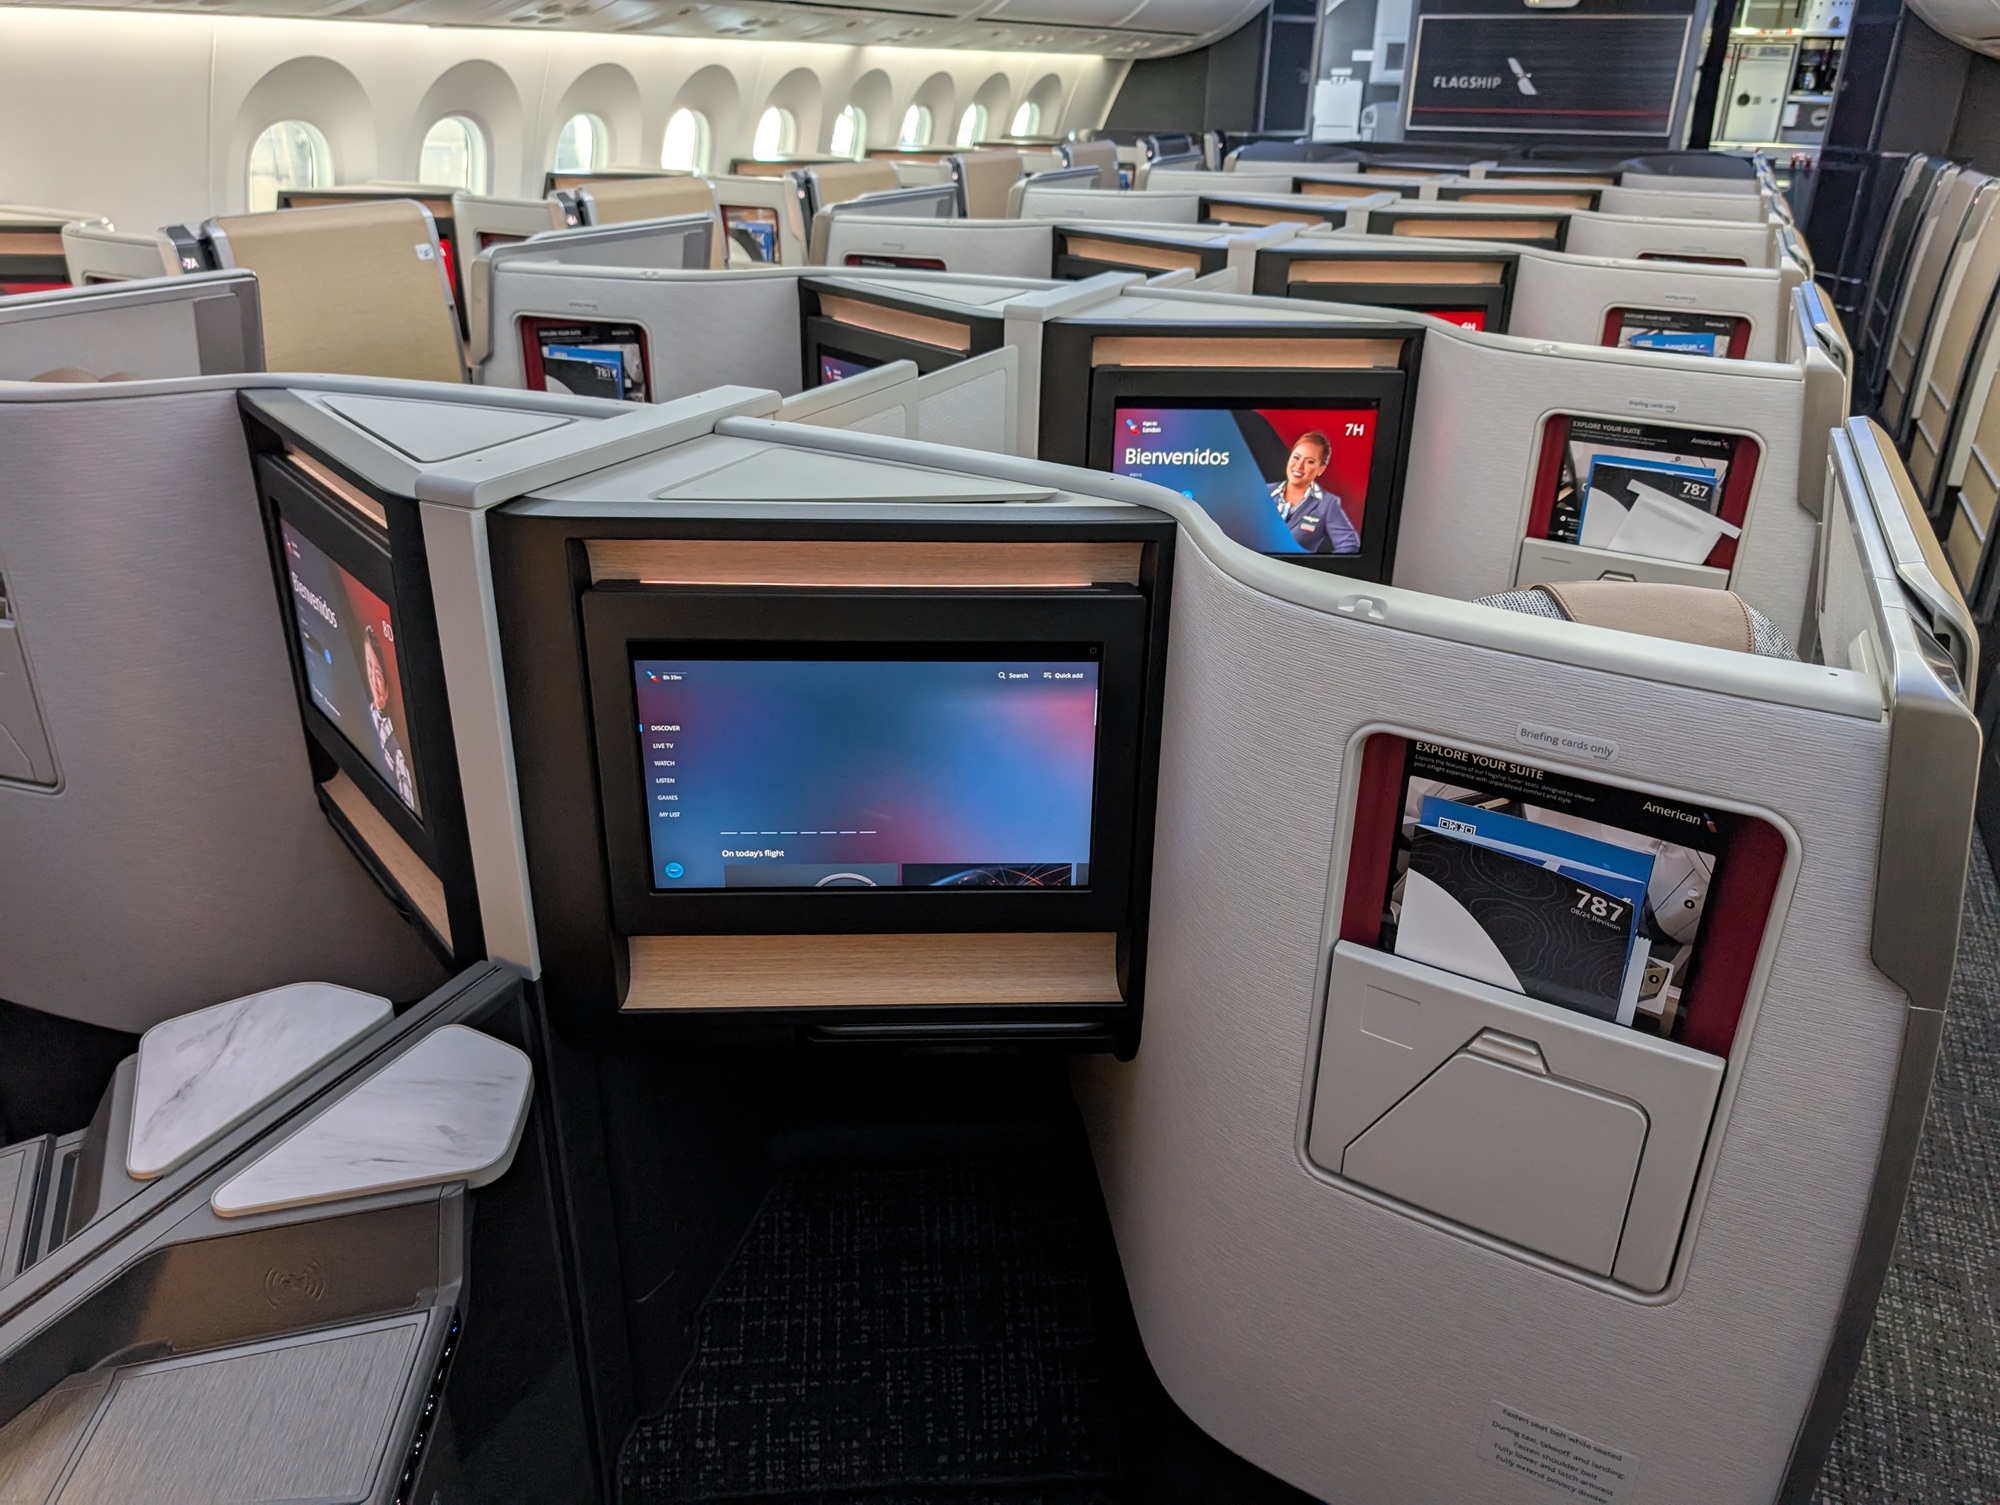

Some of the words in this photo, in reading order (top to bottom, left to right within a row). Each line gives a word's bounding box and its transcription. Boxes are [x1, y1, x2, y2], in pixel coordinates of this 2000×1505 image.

[1433, 76, 1502, 89] FLAGSHIP
[1345, 423, 1365, 436] 7H
[1572, 421, 1601, 430] EXPLORE
[1602, 424, 1622, 433] YOUR
[1622, 426, 1641, 435] SUITE
[1690, 437, 1721, 447] American
[1125, 447, 1230, 466] Bienvenidos
[1682, 481, 1709, 497] 787
[291, 570, 338, 629] Bienvenidos
[1520, 728, 1559, 746] Briefing
[1561, 738, 1588, 751] cards
[1590, 745, 1613, 758] only
[1415, 754, 1435, 764] Explore
[1445, 761, 1467, 771] features
[1416, 742, 1469, 762] EXPLORE
[1472, 754, 1506, 771] YOUR
[1509, 763, 1544, 780] SUITE
[1446, 768, 1474, 779] experience
[1522, 787, 1545, 798] comfort
[1643, 801, 1701, 825] American
[764, 849, 785, 859] flight
[1576, 888, 1624, 922] 787
[1570, 907, 1591, 919] 08/24
[1592, 916, 1621, 931] Revision
[1492, 1420, 1520, 1438] During
[1573, 1455, 1590, 1465] and
[1503, 1408, 1529, 1424] Fasten
[1530, 1421, 1548, 1432] seat
[1550, 1428, 1566, 1439] belt
[1568, 1436, 1592, 1449] while
[1593, 1447, 1622, 1461] seated
[1494, 1442, 1513, 1456] Fully
[1515, 1451, 1538, 1465] lower
[1540, 1463, 1556, 1473] and
[1558, 1469, 1578, 1482] latch
[1580, 1480, 1614, 1496] armrest
[1514, 1441, 1540, 1456] Fasten
[1542, 1454, 1578, 1472] shoulder
[1581, 1469, 1598, 1480] belt
[1495, 1454, 1514, 1467] Fully
[1516, 1464, 1545, 1479] extend
[1546, 1476, 1577, 1493] privacy
[1578, 1489, 1608, 1504] divider
